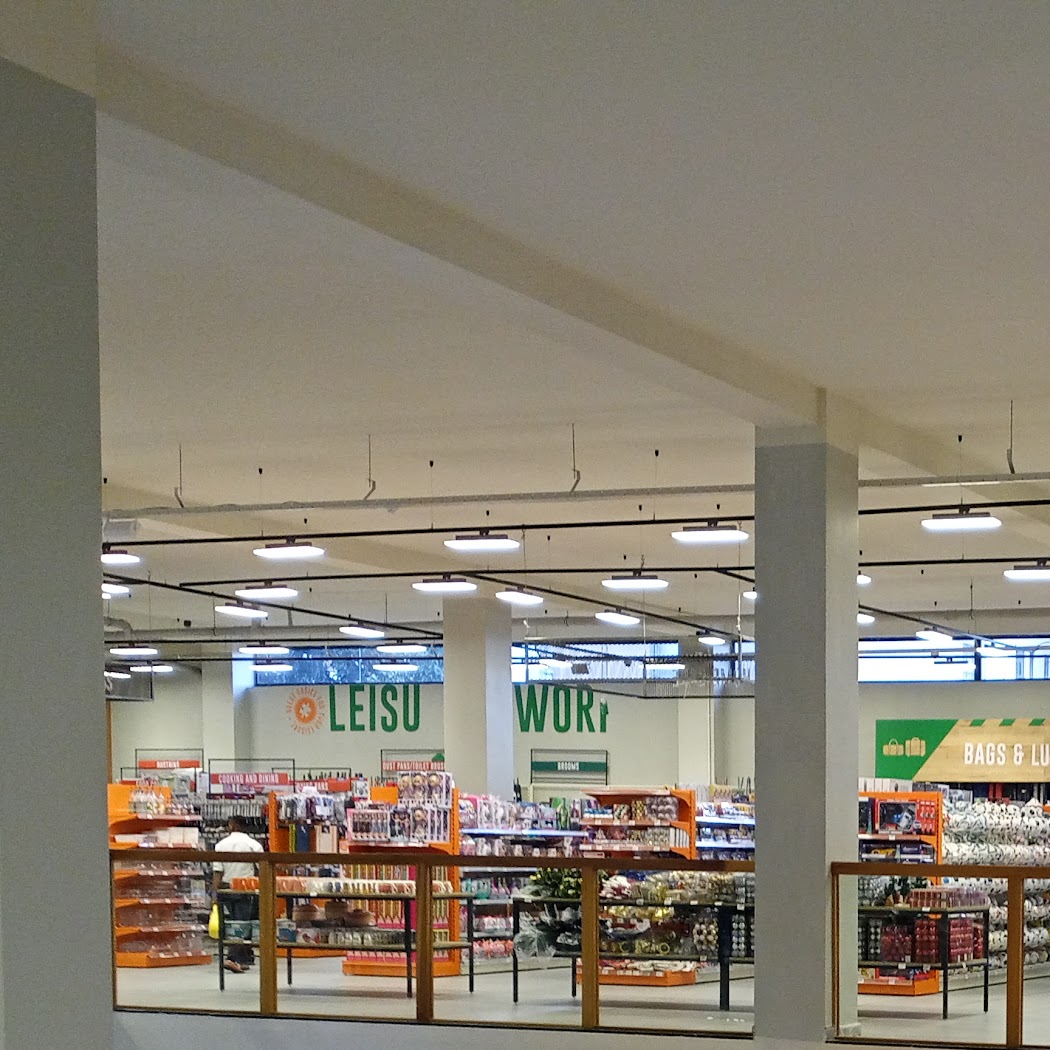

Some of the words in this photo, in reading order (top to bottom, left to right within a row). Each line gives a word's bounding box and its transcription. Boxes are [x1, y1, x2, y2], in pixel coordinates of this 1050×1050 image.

[329, 684, 420, 732] LEISU
[964, 742, 1006, 766] BAGS
[1013, 743, 1025, 766] &
[430, 761, 445, 771] BRUS
[218, 773, 244, 785] COOKING
[245, 773, 257, 785] AND
[258, 773, 279, 784] DINING
